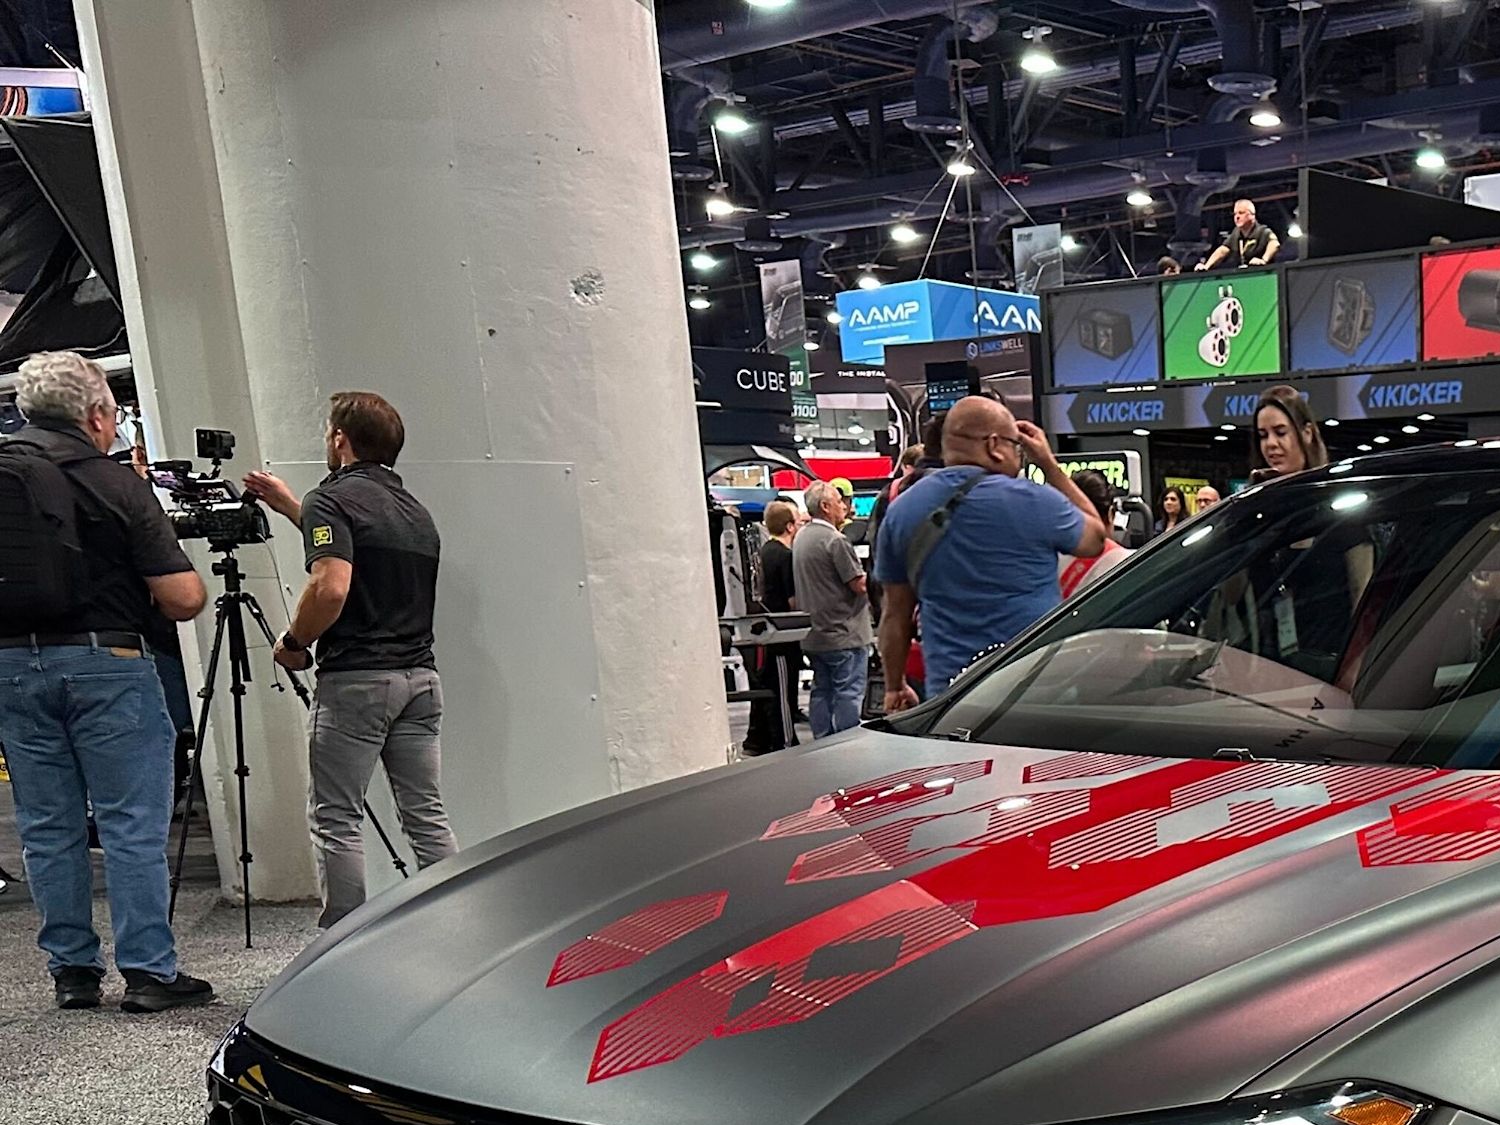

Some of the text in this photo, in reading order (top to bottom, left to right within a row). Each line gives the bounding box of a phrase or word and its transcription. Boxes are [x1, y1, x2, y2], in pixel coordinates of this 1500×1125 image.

[850, 300, 920, 328] AAMP
[737, 368, 787, 393] CUBE
[1385, 381, 1462, 407] KICKER
[1100, 400, 1165, 422] KICKER
